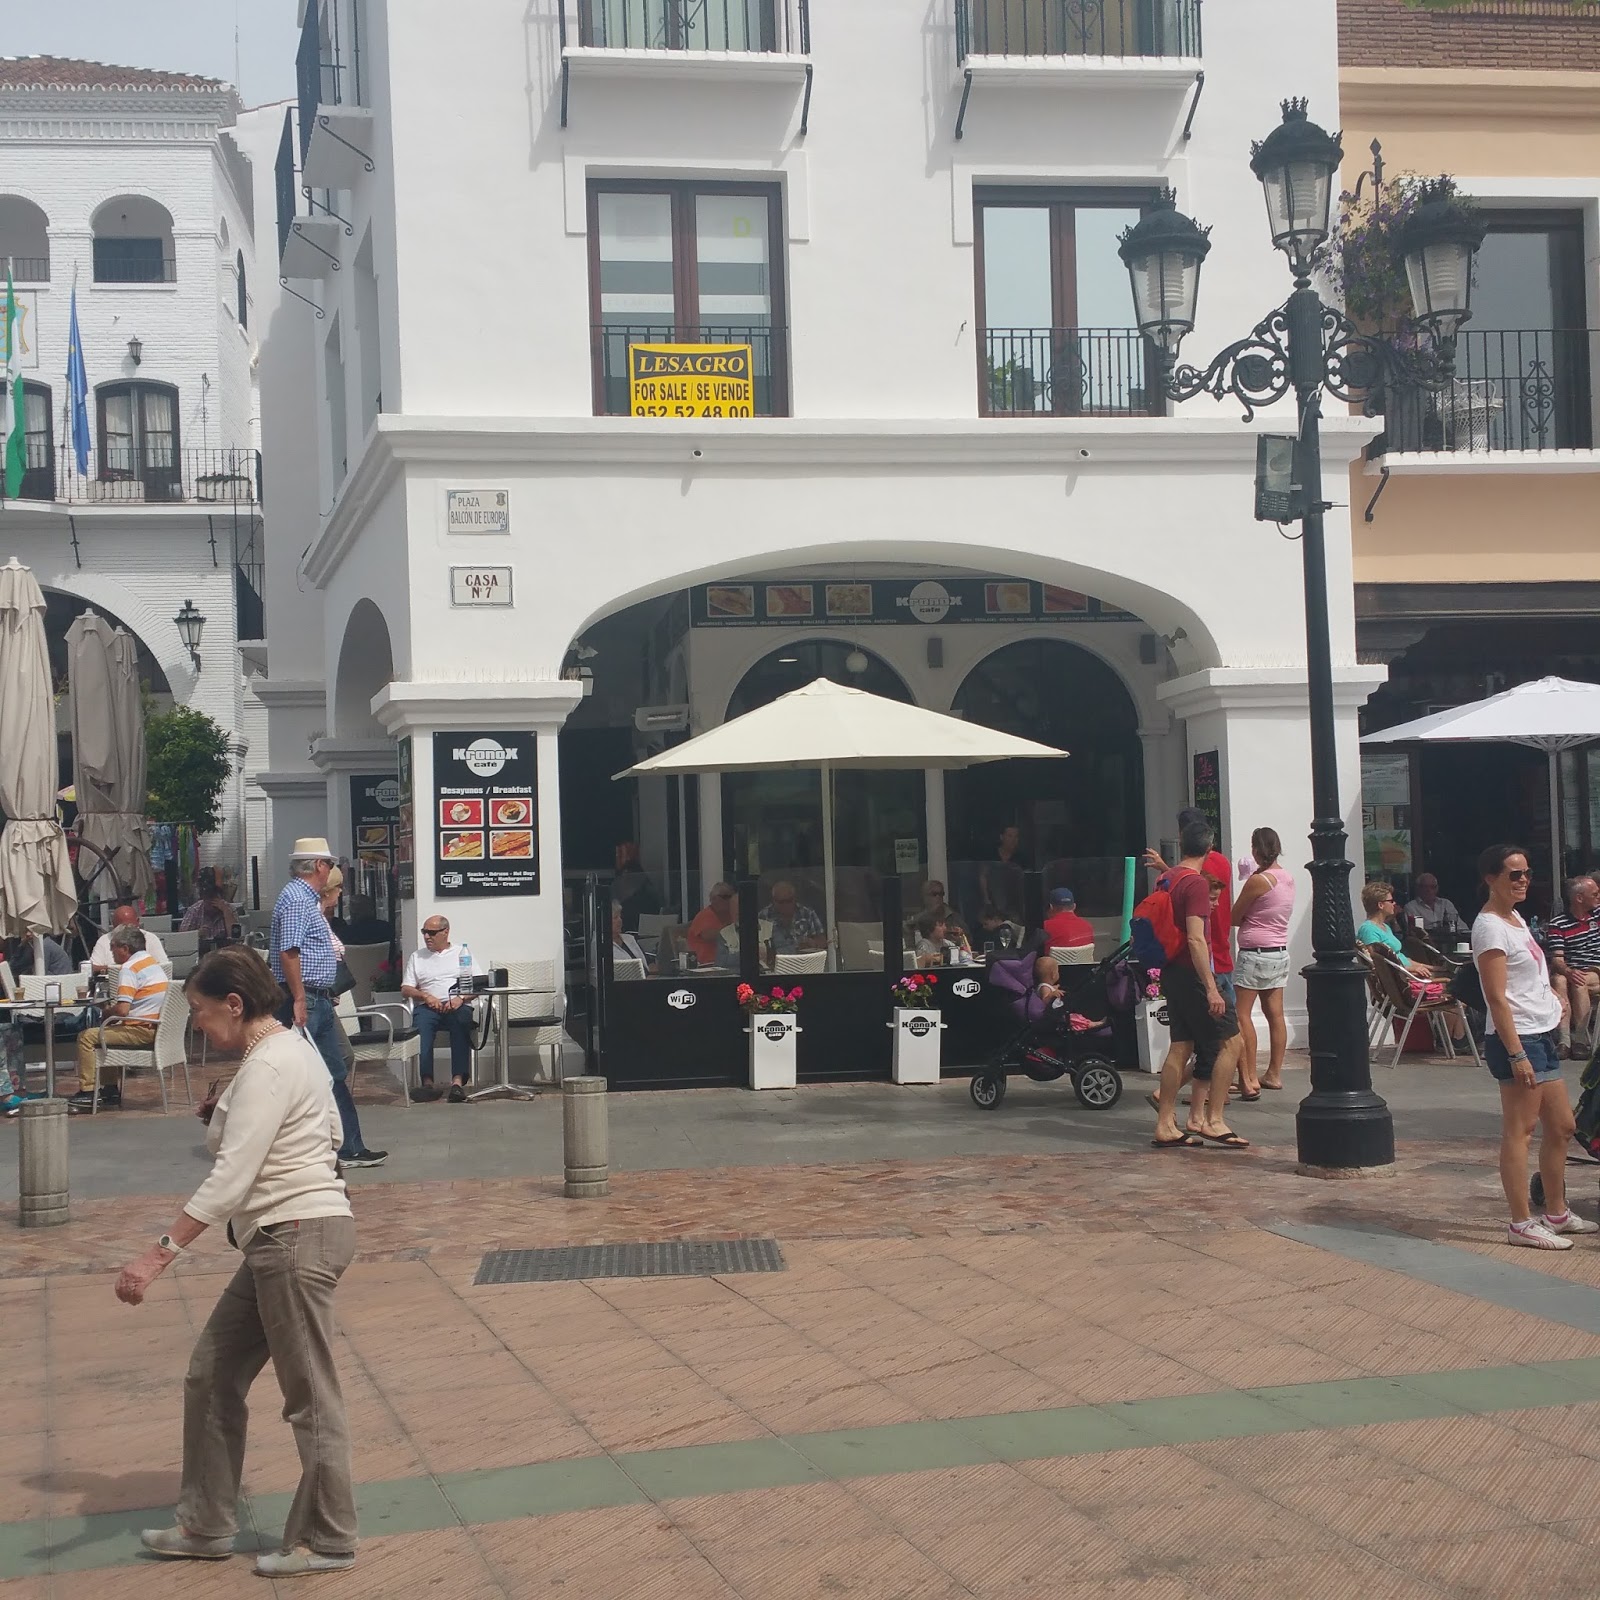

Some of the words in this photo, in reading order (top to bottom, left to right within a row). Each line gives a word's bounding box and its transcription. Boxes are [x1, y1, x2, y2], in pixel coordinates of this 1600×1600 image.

[638, 356, 745, 373] LESAGRO
[635, 383, 656, 401] FOR
[660, 383, 687, 401] SALE
[697, 383, 710, 400] SE
[713, 383, 749, 400] VENDE
[636, 406, 668, 417] 952
[675, 406, 695, 417] 52
[702, 406, 722, 417] 48
[729, 406, 749, 417] 00
[458, 497, 480, 507] PLAZA
[475, 511, 482, 524] DE
[484, 511, 506, 524] EUROPA
[465, 575, 498, 587] CASA
[486, 587, 492, 599] 7
[896, 596, 962, 607] KronoX
[452, 748, 518, 760] KronoX
[365, 787, 398, 797] Kron
[440, 787, 483, 795] Desayunos
[757, 1025, 792, 1033] KronoX
